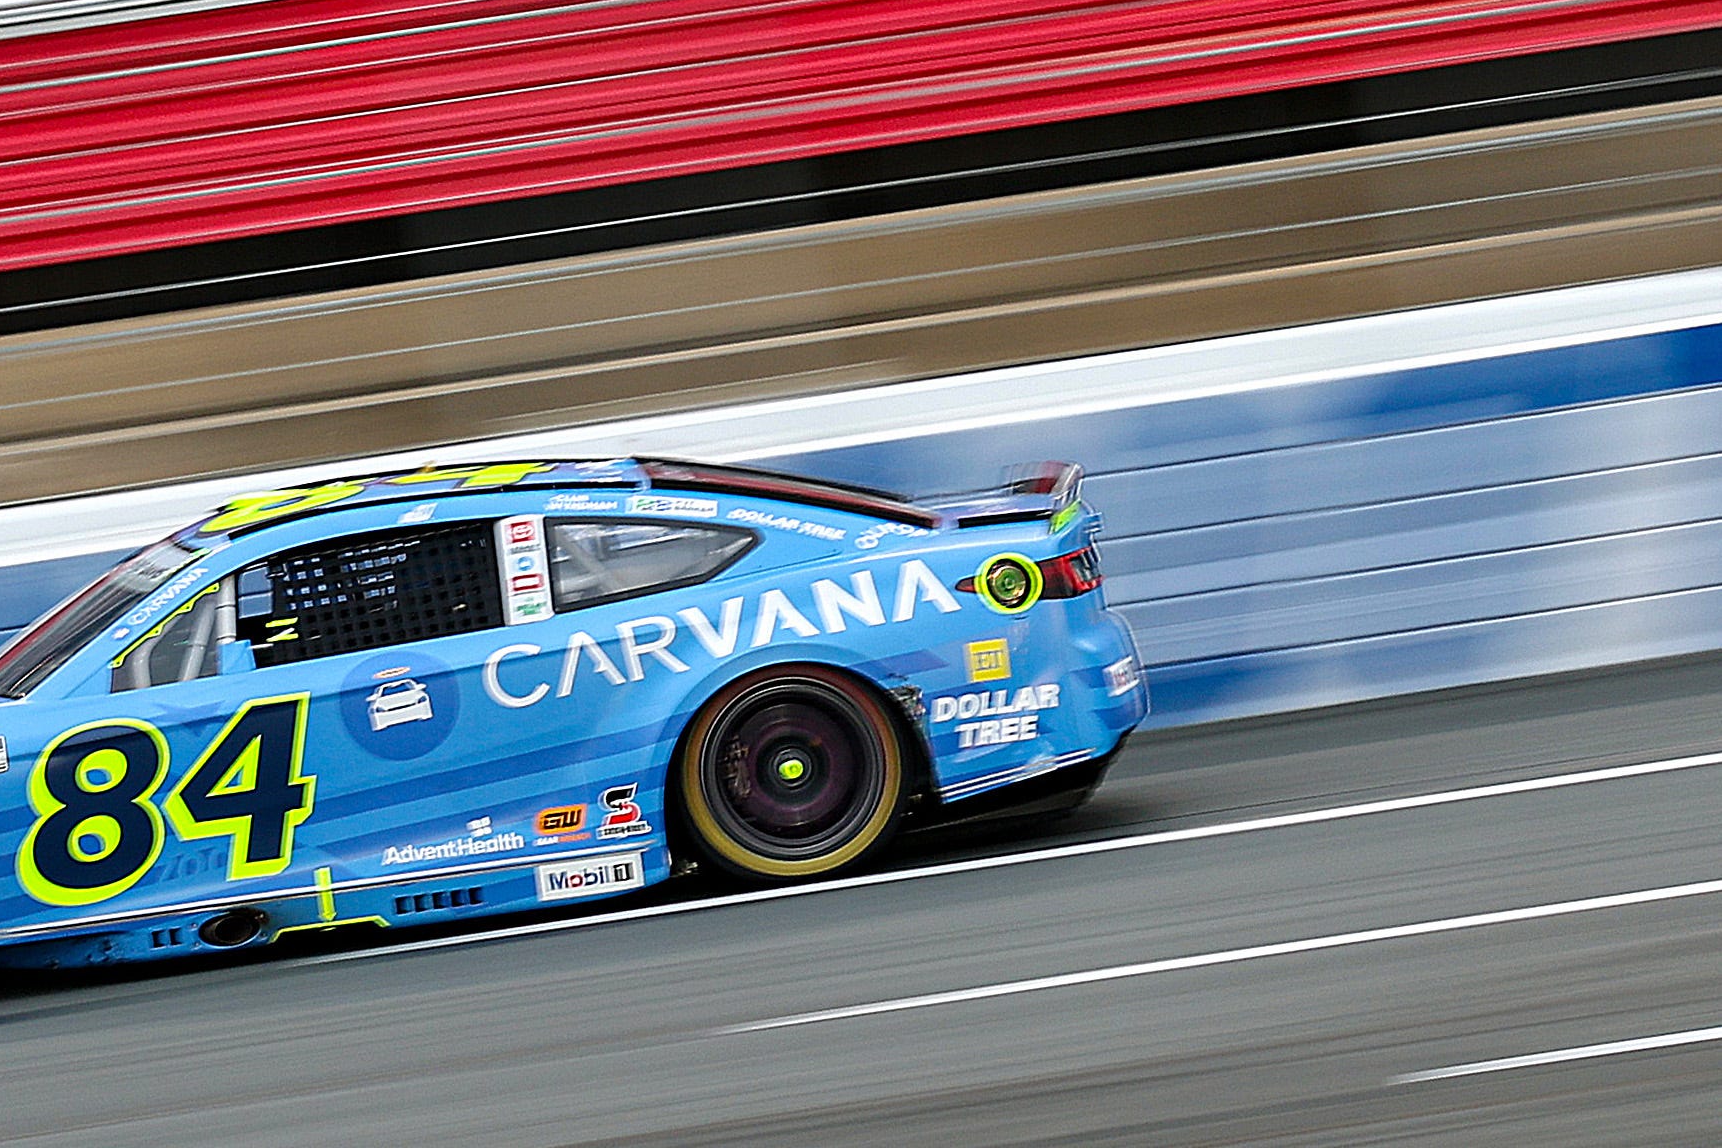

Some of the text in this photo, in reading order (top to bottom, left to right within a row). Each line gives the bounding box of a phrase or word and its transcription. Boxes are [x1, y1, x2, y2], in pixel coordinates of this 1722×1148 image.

[726, 508, 801, 531] DOLLAR
[129, 566, 209, 625] CARVANA
[481, 559, 963, 709] CARVANA
[931, 683, 1060, 723] DOLLAR
[954, 715, 1040, 749] TREE
[16, 691, 318, 905] 84
[381, 832, 525, 866] AdventHealth
[548, 865, 609, 890] Mobil
